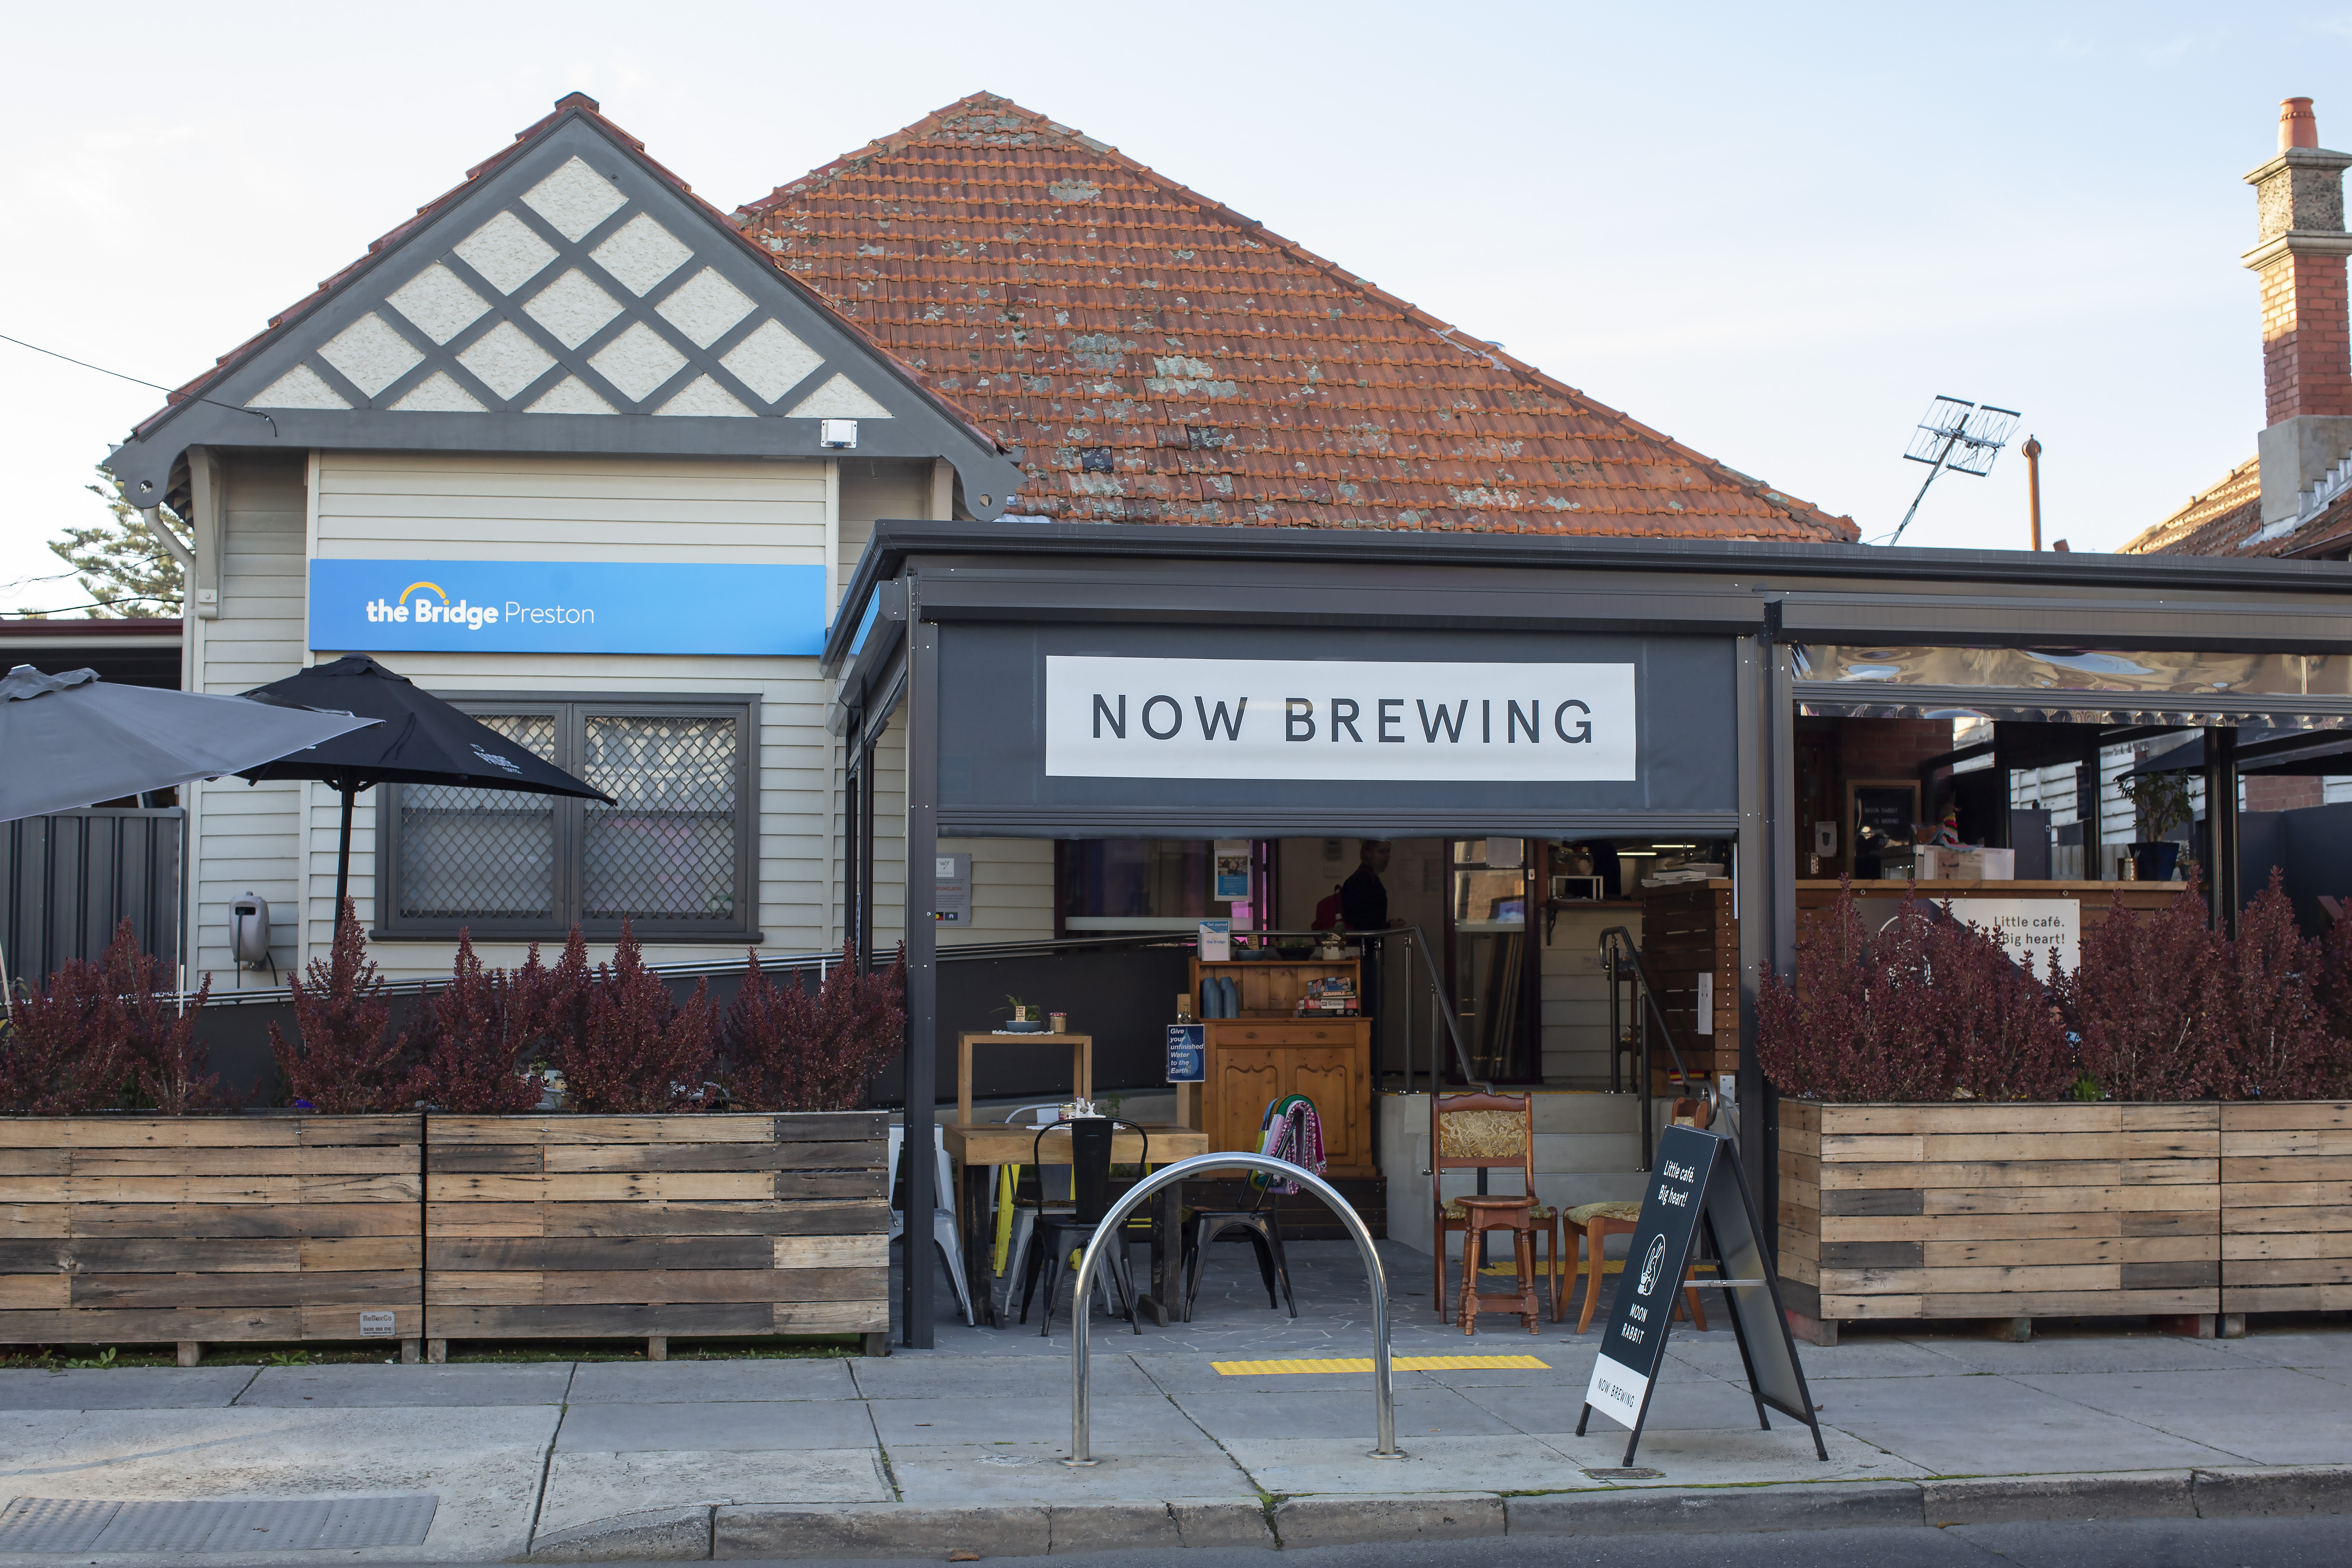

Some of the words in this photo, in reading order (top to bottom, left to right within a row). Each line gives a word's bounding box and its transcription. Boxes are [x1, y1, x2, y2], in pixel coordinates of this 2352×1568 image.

[367, 599, 409, 622] the
[416, 599, 499, 630] Bridge
[506, 601, 594, 623] Preston
[1093, 694, 1248, 741] NOW
[1286, 697, 1592, 744] BREWING
[1994, 916, 2028, 927] Little
[2033, 916, 2065, 927] café.
[2002, 933, 2021, 947] Big
[2026, 933, 2065, 944] heart!
[1663, 1160, 1680, 1179] Little
[1680, 1166, 1695, 1183] café.
[1658, 1184, 1669, 1205] Big
[1668, 1187, 1688, 1207] heart!
[1629, 1303, 1648, 1323] MOON
[1621, 1323, 1645, 1344] RABBIT
[1597, 1377, 1611, 1394] NOW
[1610, 1385, 1635, 1408] BREWING
